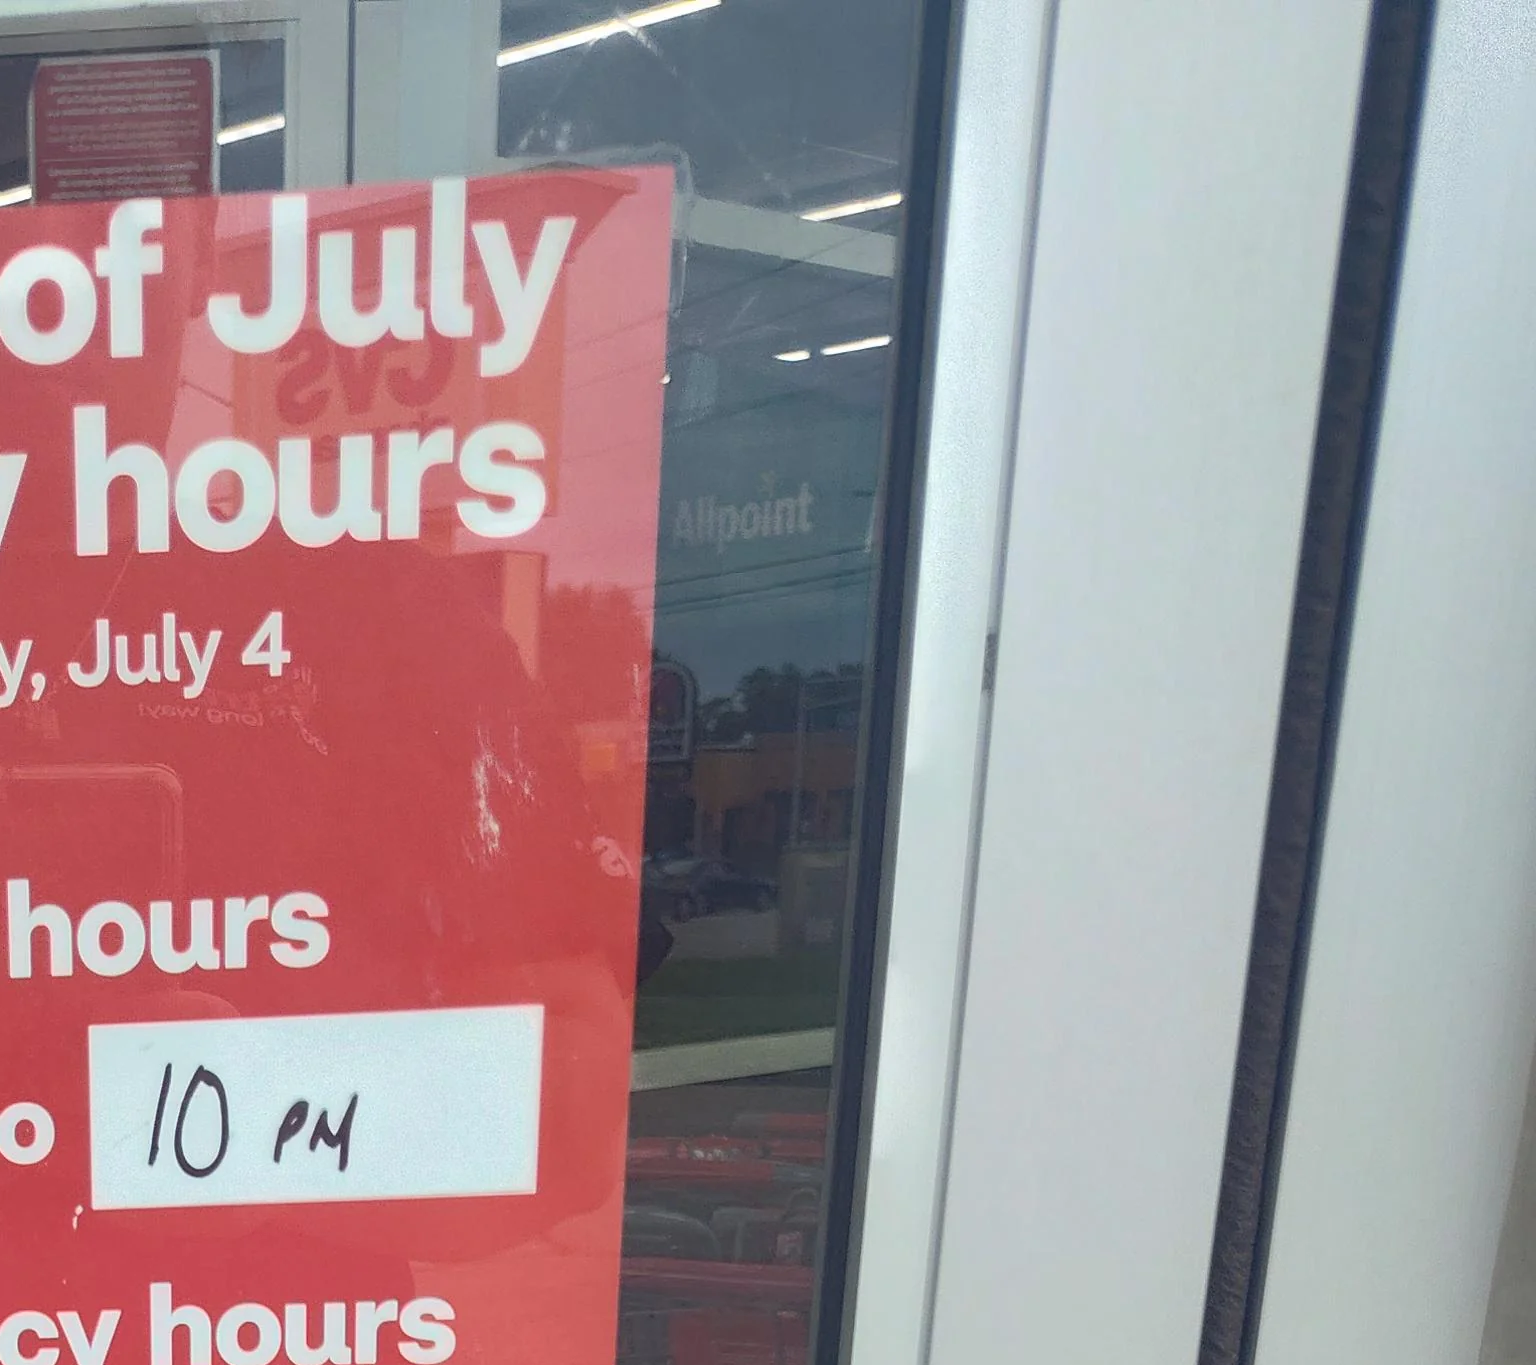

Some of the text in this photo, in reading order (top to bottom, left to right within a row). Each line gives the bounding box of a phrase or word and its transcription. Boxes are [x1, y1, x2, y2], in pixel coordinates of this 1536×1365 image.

[208, 178, 577, 378] July
[72, 405, 548, 558] hours
[671, 482, 816, 554] Allpoint
[67, 612, 223, 699] July
[241, 611, 291, 678] 4
[7, 878, 330, 978] hours
[148, 1063, 229, 1178] 10
[273, 1094, 358, 1171] PM
